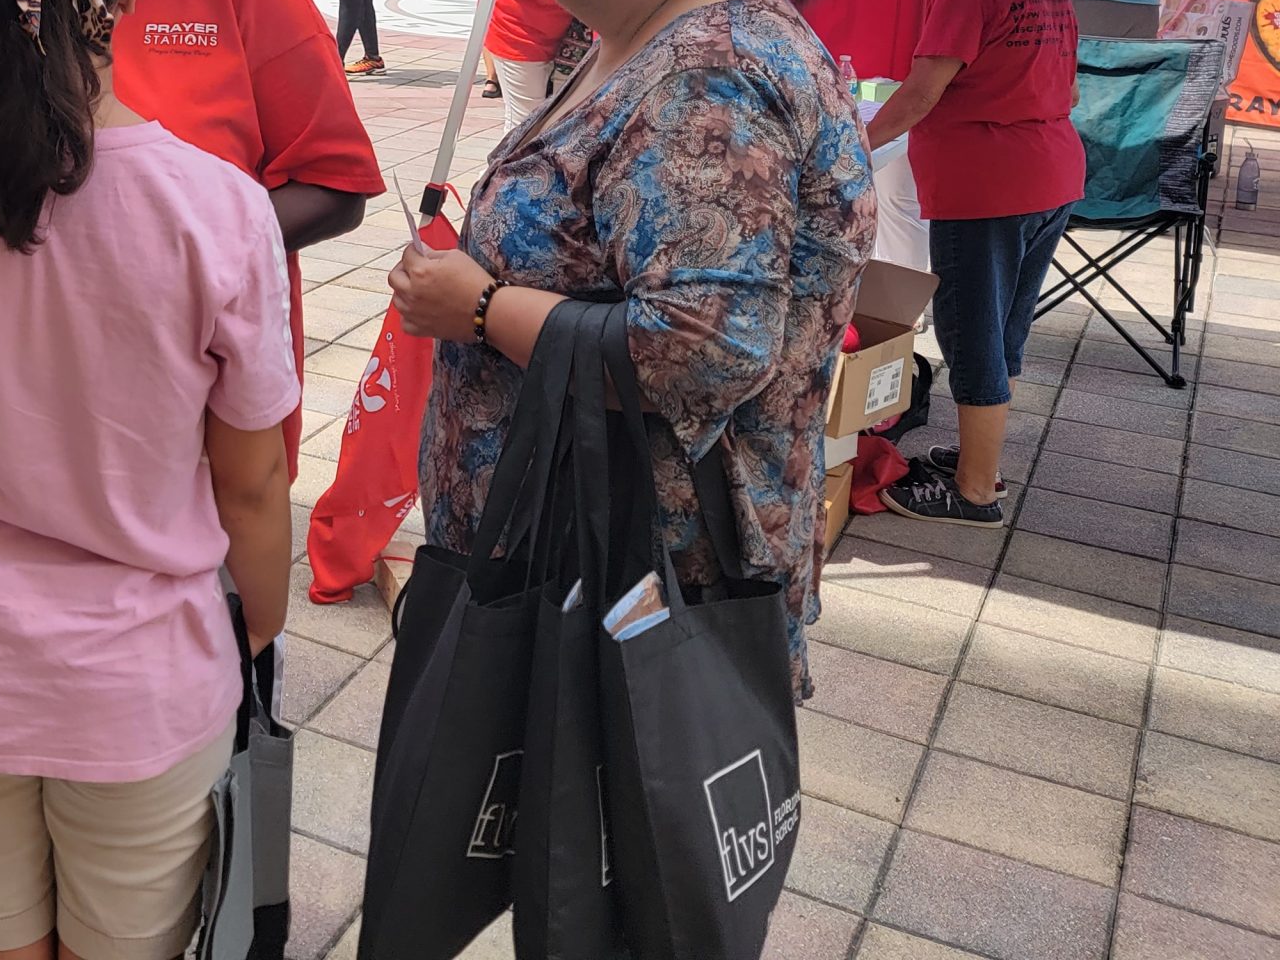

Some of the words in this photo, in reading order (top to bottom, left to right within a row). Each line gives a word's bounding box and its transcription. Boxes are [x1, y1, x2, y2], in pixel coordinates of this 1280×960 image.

[145, 22, 218, 34] PRAYER
[143, 34, 218, 46] STATIONS
[1006, 40, 1029, 48] one
[721, 821, 769, 888] flvs
